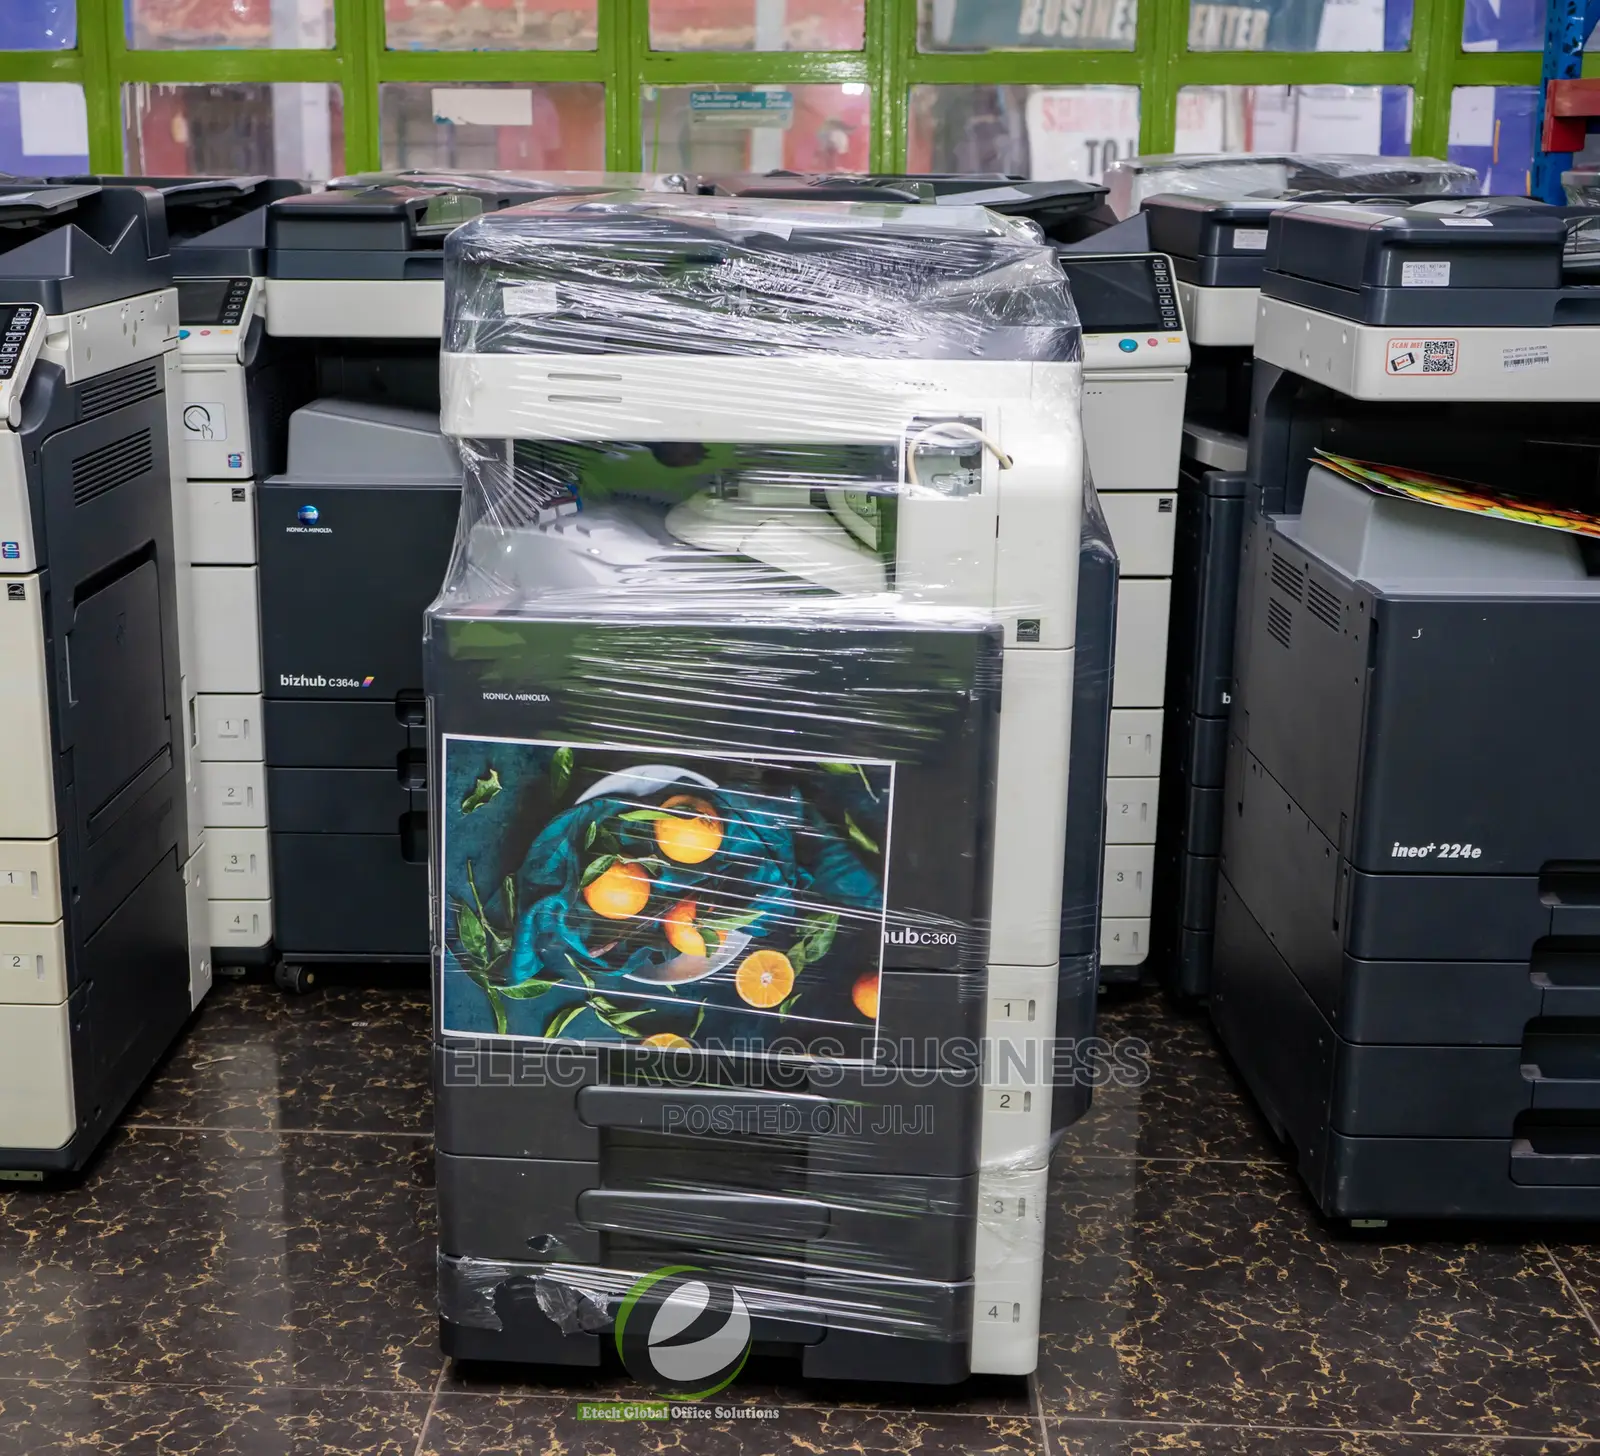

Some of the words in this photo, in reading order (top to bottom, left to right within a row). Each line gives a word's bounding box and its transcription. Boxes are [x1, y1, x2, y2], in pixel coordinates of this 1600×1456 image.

[1410, 341, 1423, 349] ME!
[280, 674, 327, 687] bizhub
[328, 678, 360, 688] C364e
[482, 692, 514, 701] KONICA
[515, 693, 551, 702] MINOLTA
[225, 720, 230, 730] 1
[1127, 735, 1132, 745] 1
[227, 788, 235, 797] 2
[1121, 803, 1129, 814] 2
[1437, 843, 1482, 859] 224e
[230, 855, 238, 865] 3
[7, 872, 14, 884] 1
[1116, 872, 1124, 882] 3
[233, 915, 241, 924] 4
[920, 933, 957, 945] C360
[1113, 933, 1120, 942] 4
[12, 955, 21, 968] 2
[1003, 1002, 1011, 1018] 1
[1000, 1094, 1011, 1109] 2
[993, 1200, 1004, 1214] 3
[987, 1305, 998, 1319] 4
